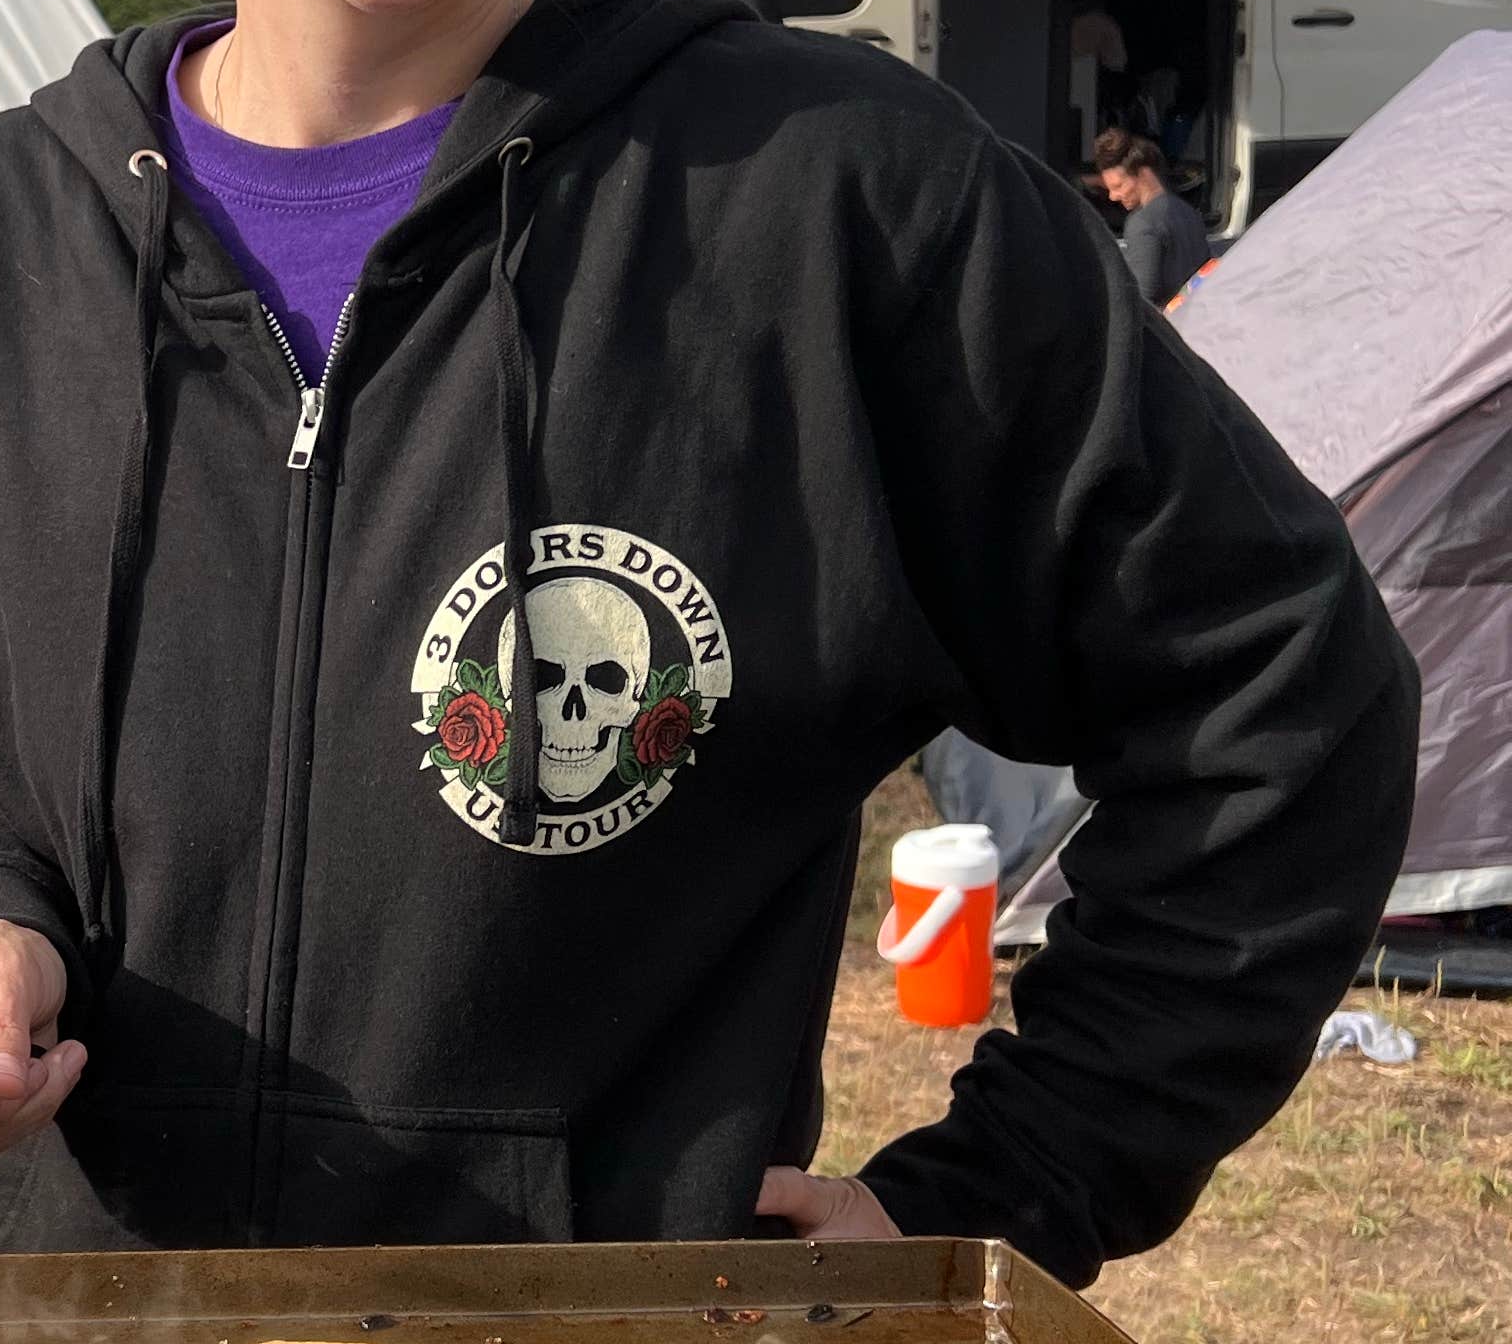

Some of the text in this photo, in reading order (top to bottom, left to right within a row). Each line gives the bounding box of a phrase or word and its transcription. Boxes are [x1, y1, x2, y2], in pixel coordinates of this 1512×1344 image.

[426, 532, 725, 664] 3 DORS DOWN
[537, 788, 654, 850] TOUR
